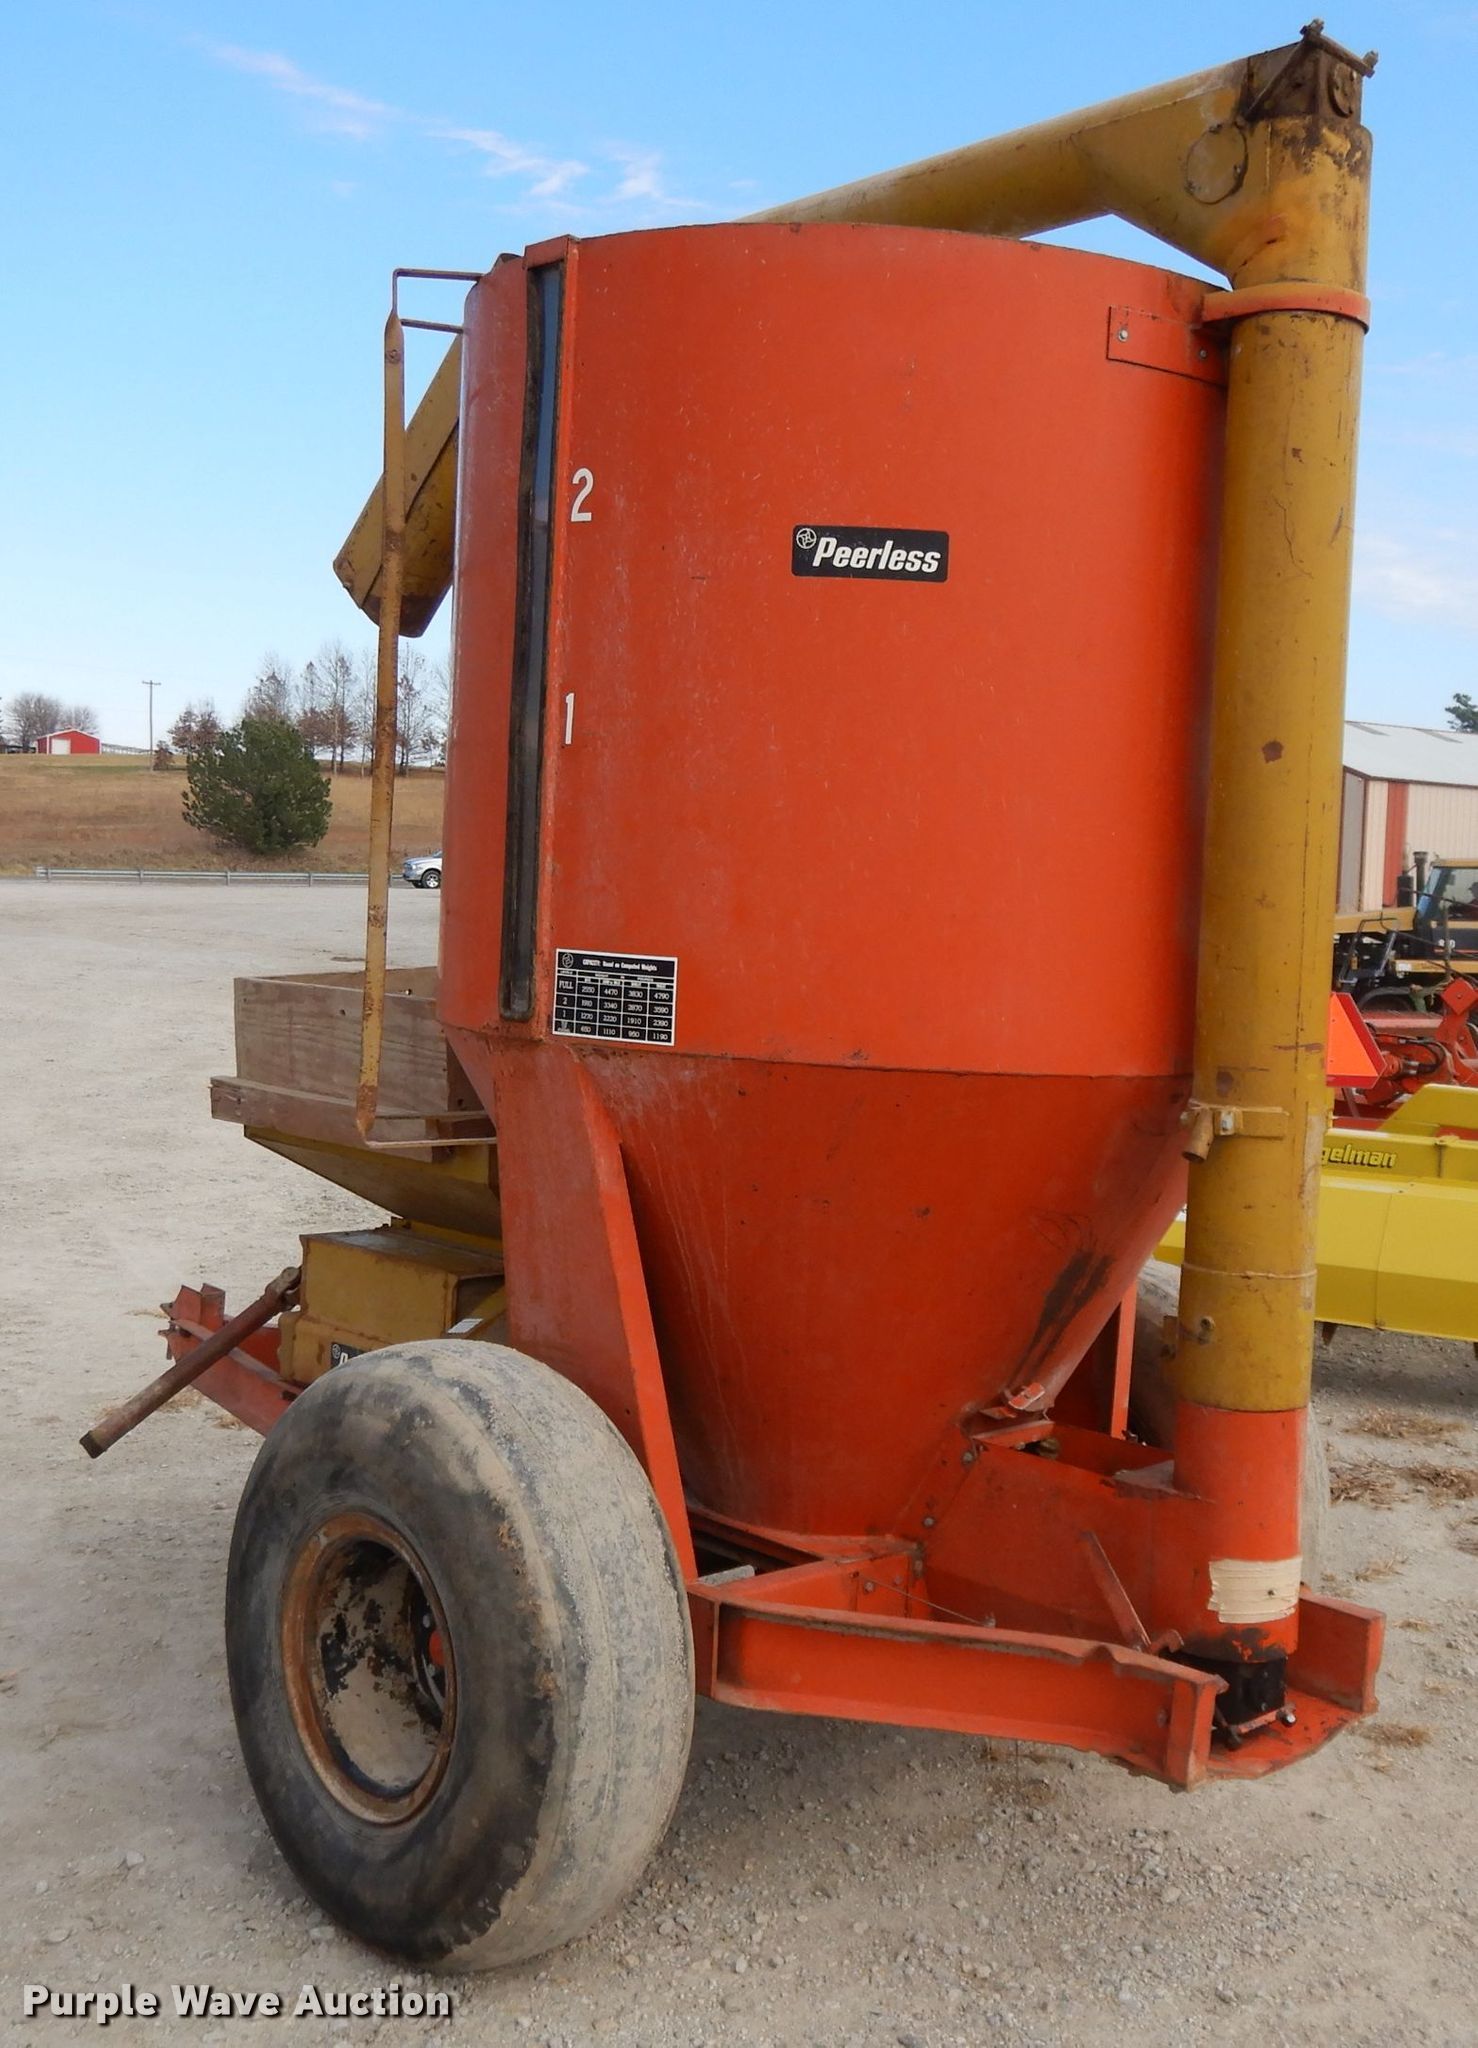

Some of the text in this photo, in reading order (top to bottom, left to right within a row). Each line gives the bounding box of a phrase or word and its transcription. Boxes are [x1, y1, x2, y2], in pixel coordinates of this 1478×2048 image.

[570, 467, 594, 522] 2
[812, 536, 942, 574] Peerless
[565, 692, 575, 745] 1
[558, 980, 574, 990] FULL
[603, 988, 619, 996] 4470
[562, 997, 568, 1005] 2
[562, 1009, 566, 1018] 1
[627, 1016, 642, 1025] 1910
[1320, 1143, 1397, 1168] gelman
